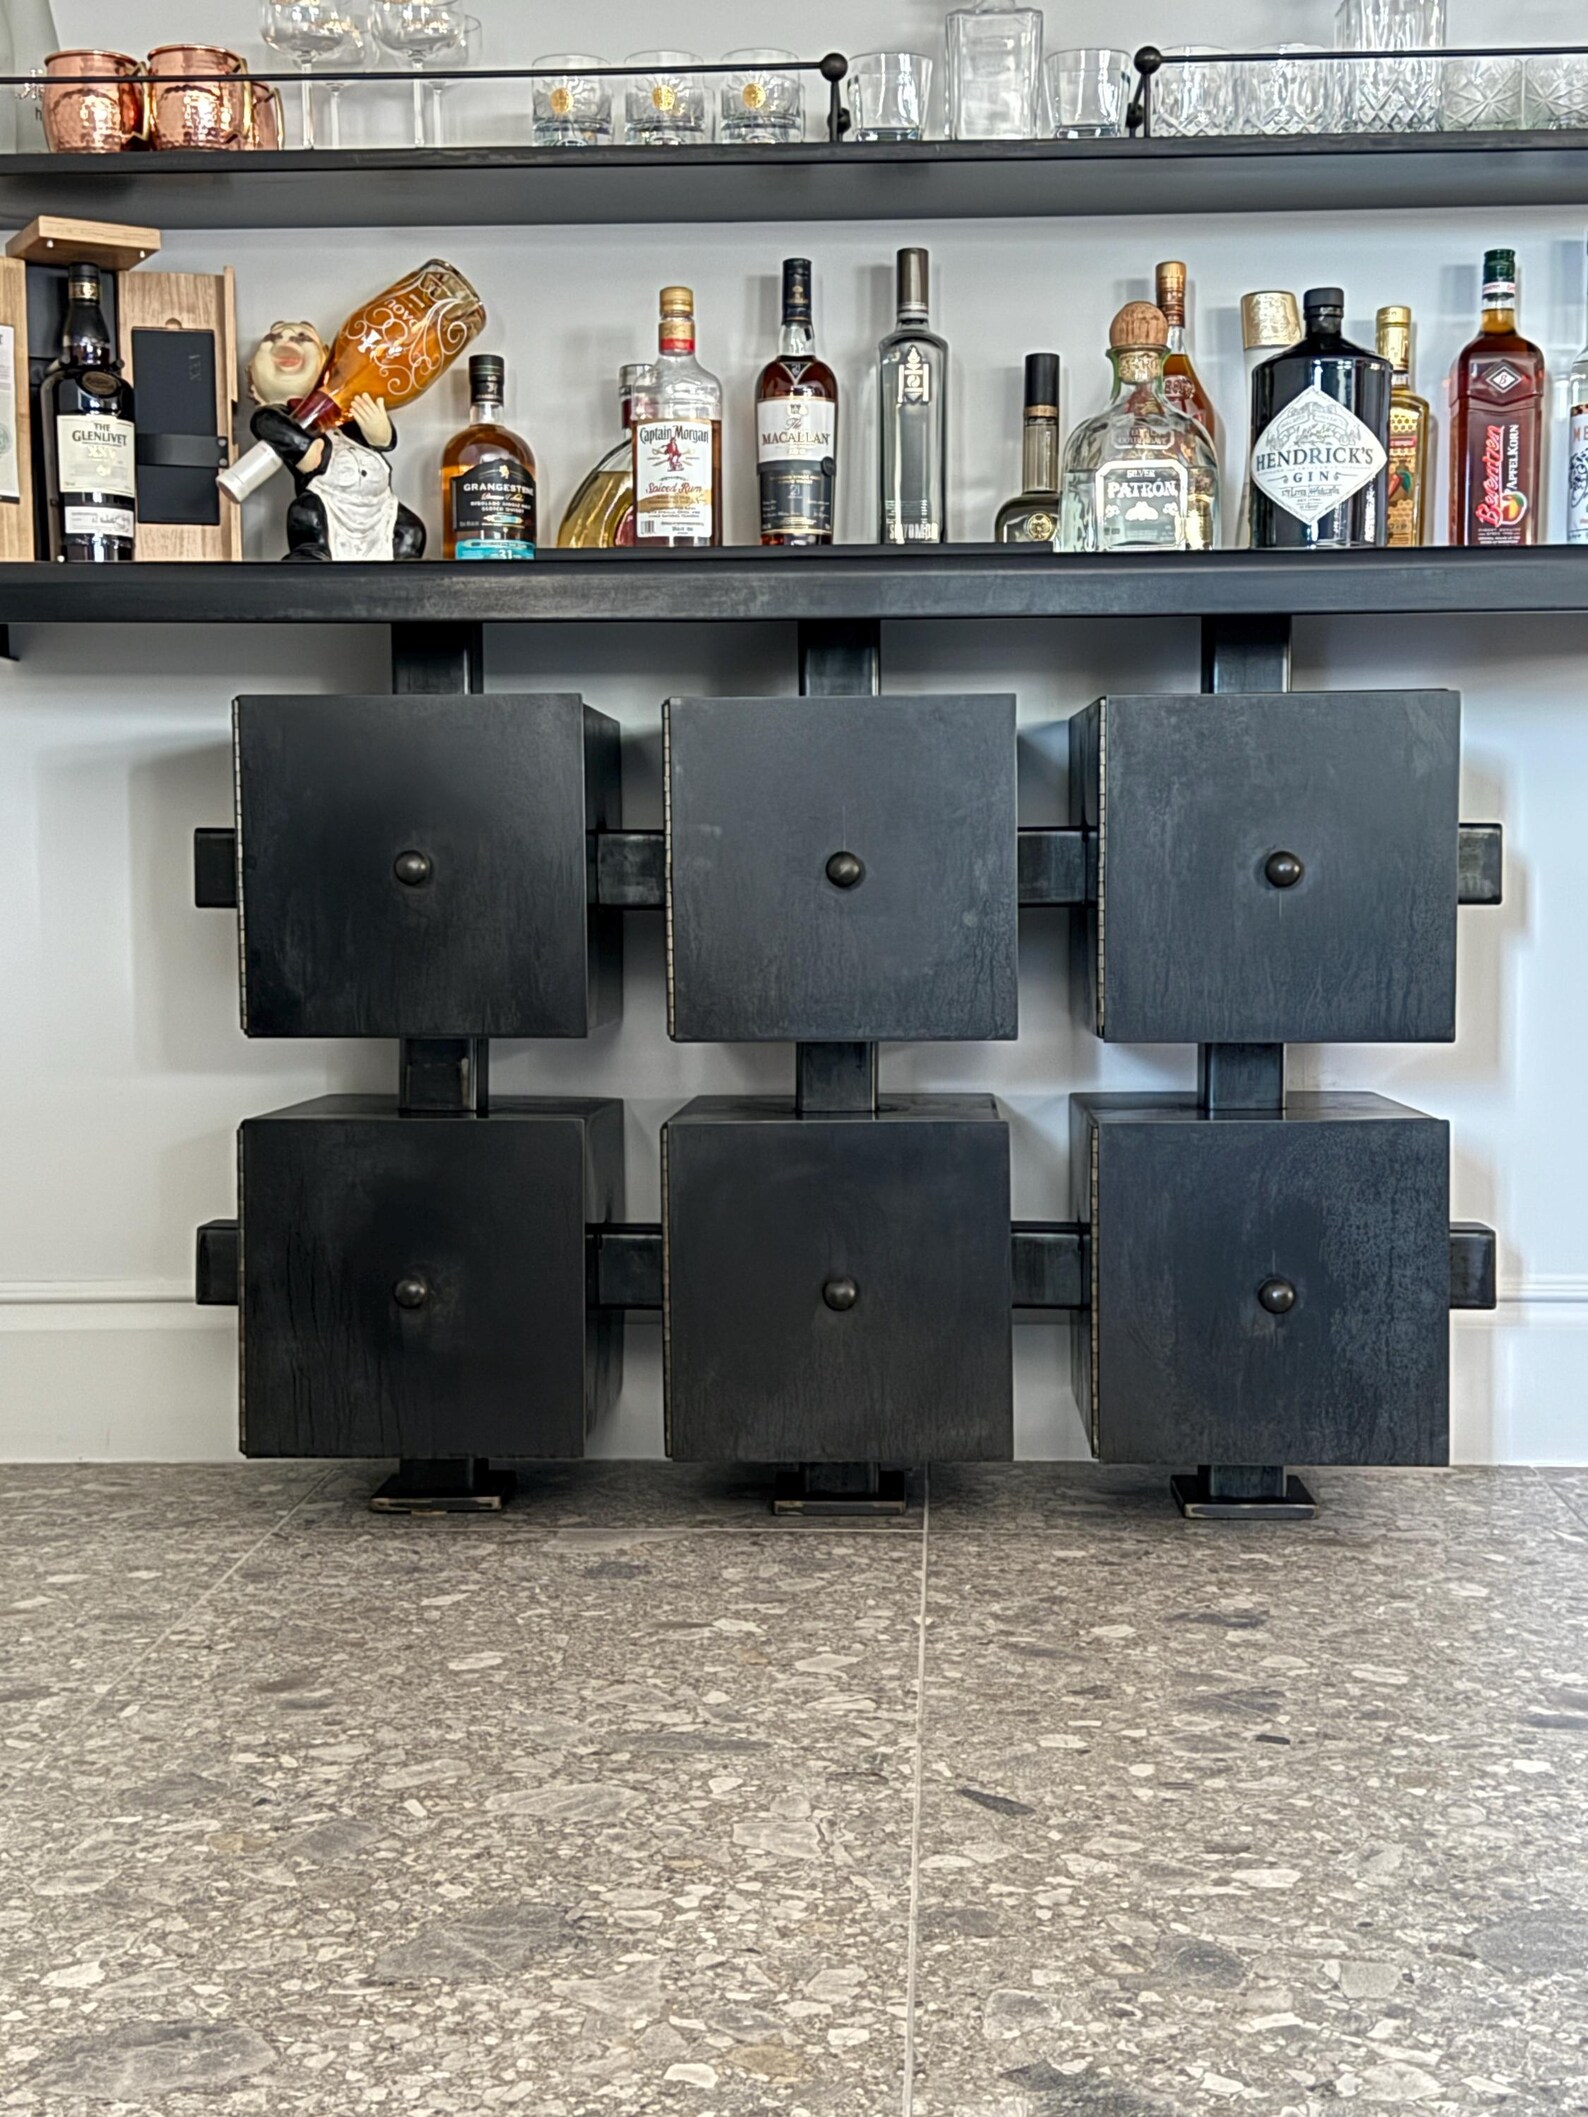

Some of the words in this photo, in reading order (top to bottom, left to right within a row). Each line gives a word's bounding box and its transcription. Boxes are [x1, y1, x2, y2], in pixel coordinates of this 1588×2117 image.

[94, 422, 111, 432] THE
[784, 417, 803, 431] The
[72, 430, 128, 447] GLENLIVET
[639, 425, 672, 445] Captain
[672, 424, 709, 444] Morgan
[761, 431, 831, 447] MACALLAN
[1255, 446, 1374, 472] HENDRICK'S
[1126, 469, 1156, 479] SILVER
[1292, 471, 1330, 483] GIN
[1475, 424, 1505, 528] Berentzen
[645, 482, 678, 494] Spiced
[678, 482, 703, 494] Rum
[1107, 479, 1179, 499] PATRÓN
